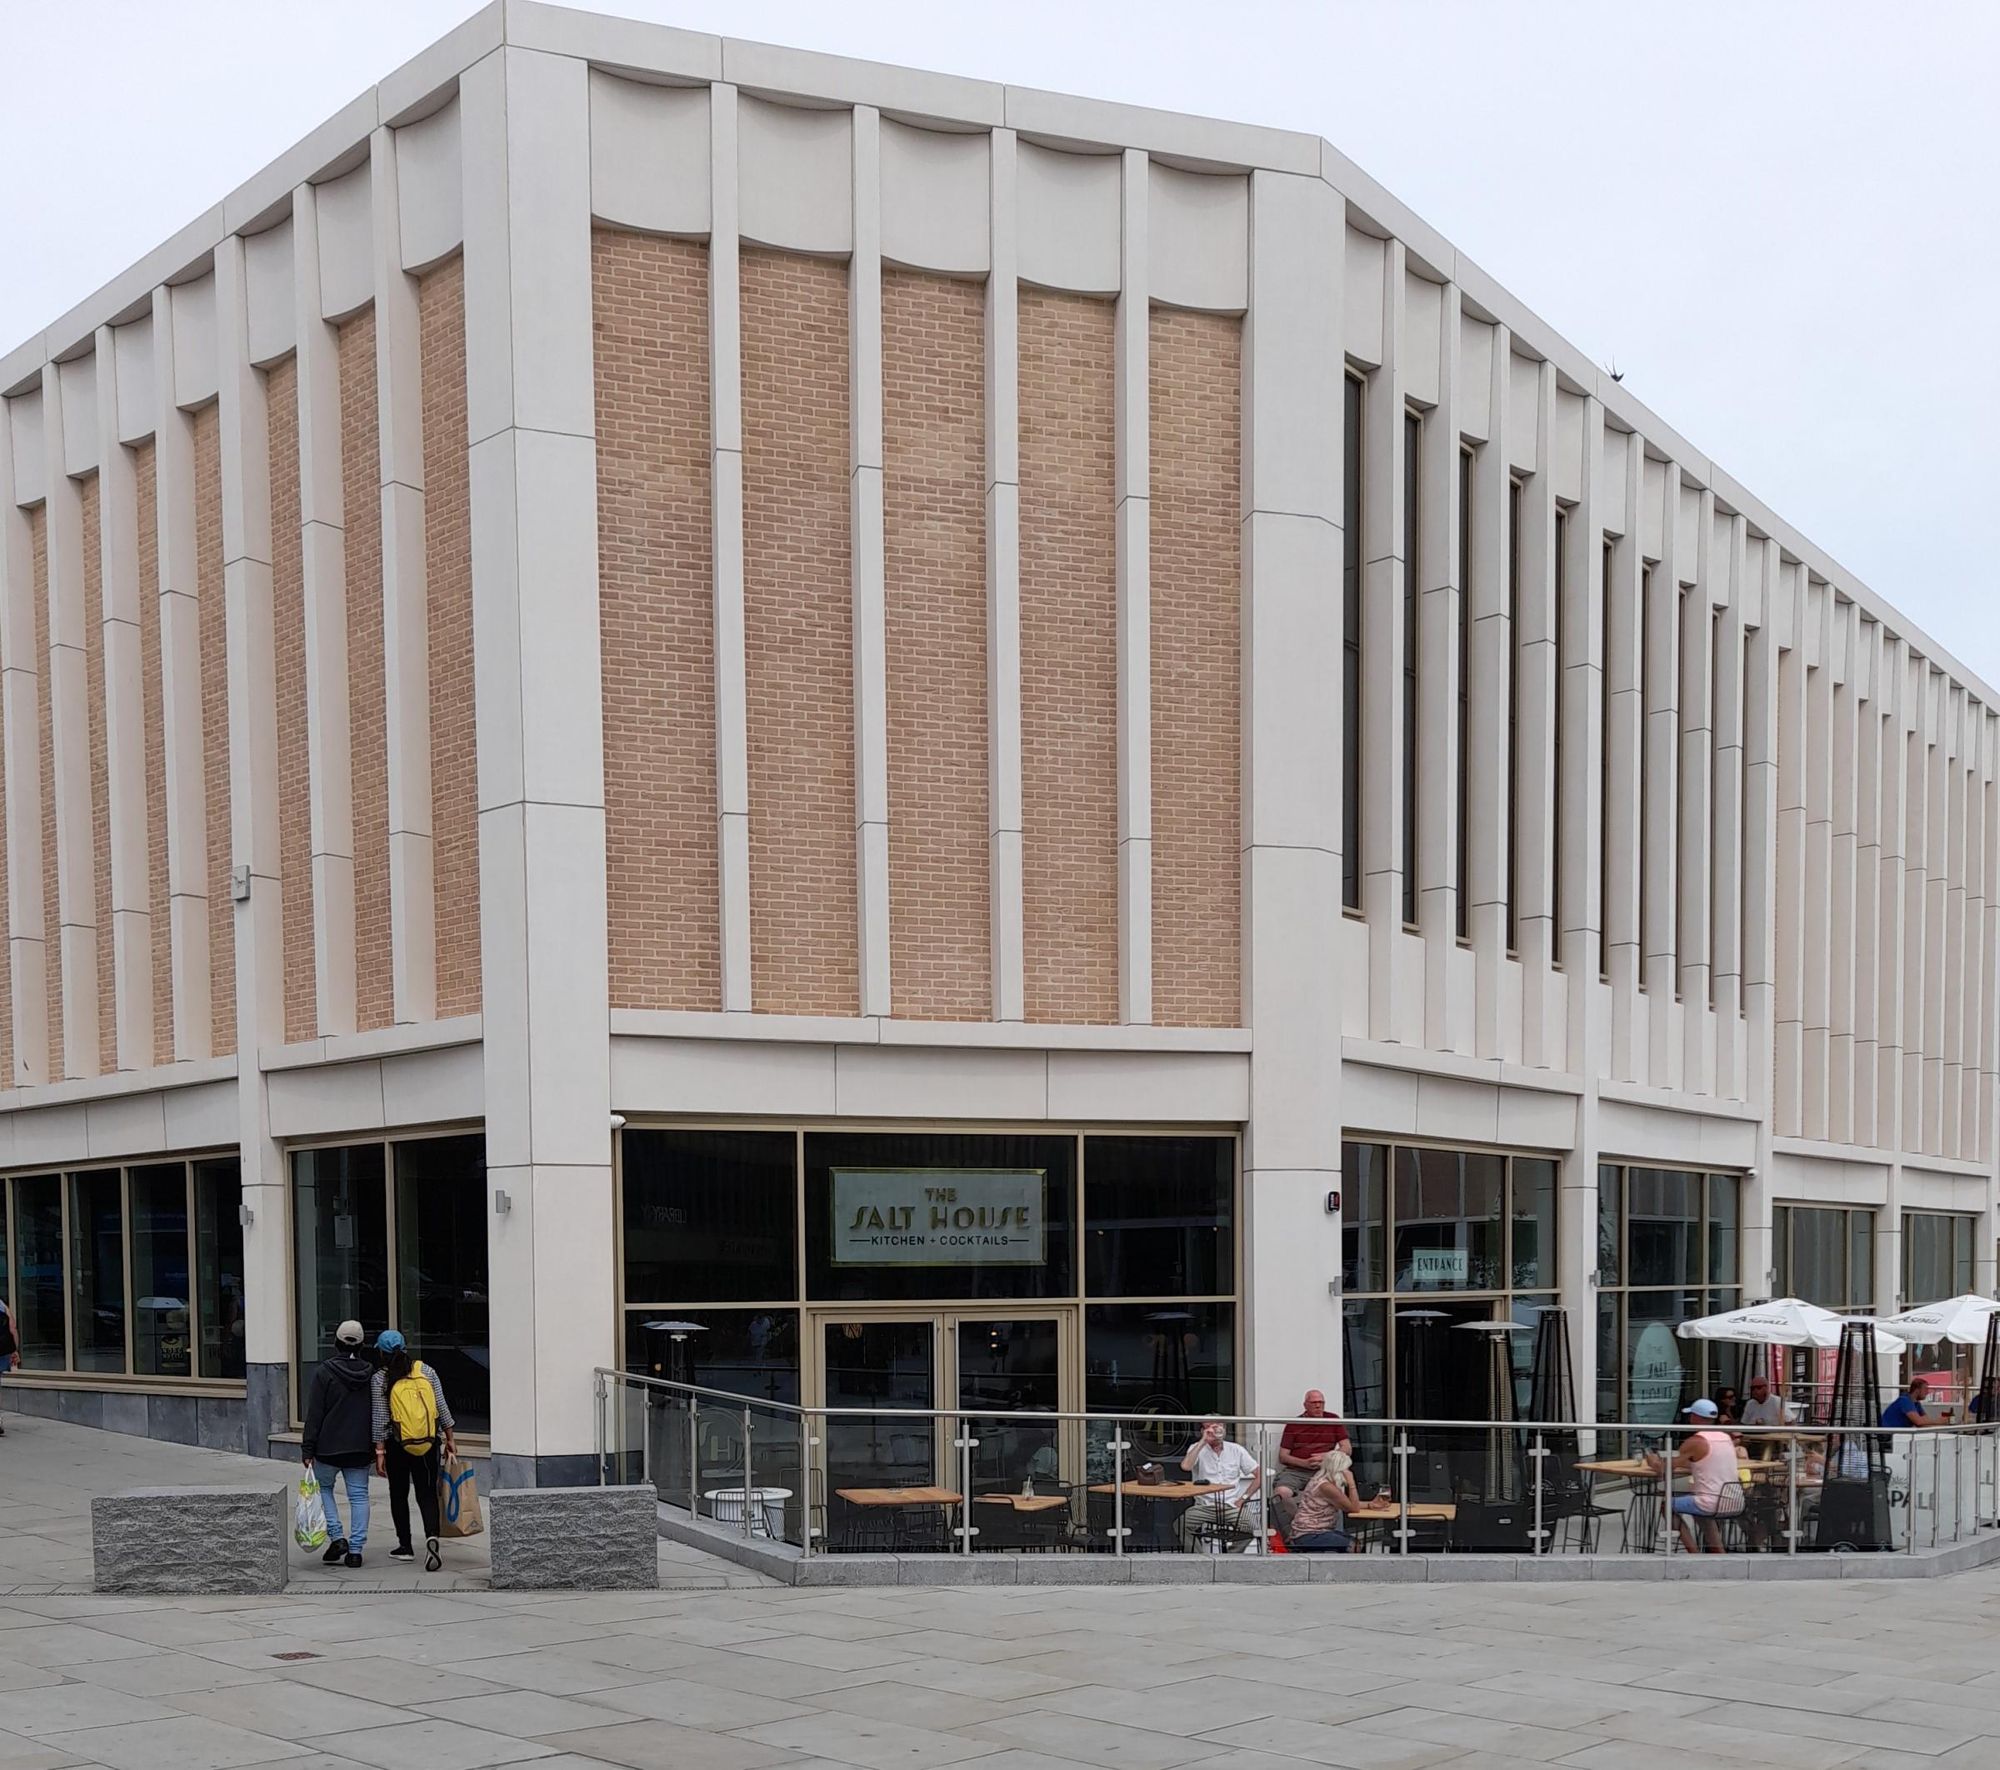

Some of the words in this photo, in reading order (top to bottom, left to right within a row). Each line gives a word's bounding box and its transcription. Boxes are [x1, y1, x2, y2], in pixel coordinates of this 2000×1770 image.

[925, 1187, 957, 1202] THE
[850, 1206, 915, 1230] SALT
[931, 1206, 1030, 1230] HOUSE
[871, 1235, 925, 1246] KITCHEN
[939, 1235, 1008, 1246] COCKTAILS
[1417, 1257, 1463, 1272] ENTRANCE
